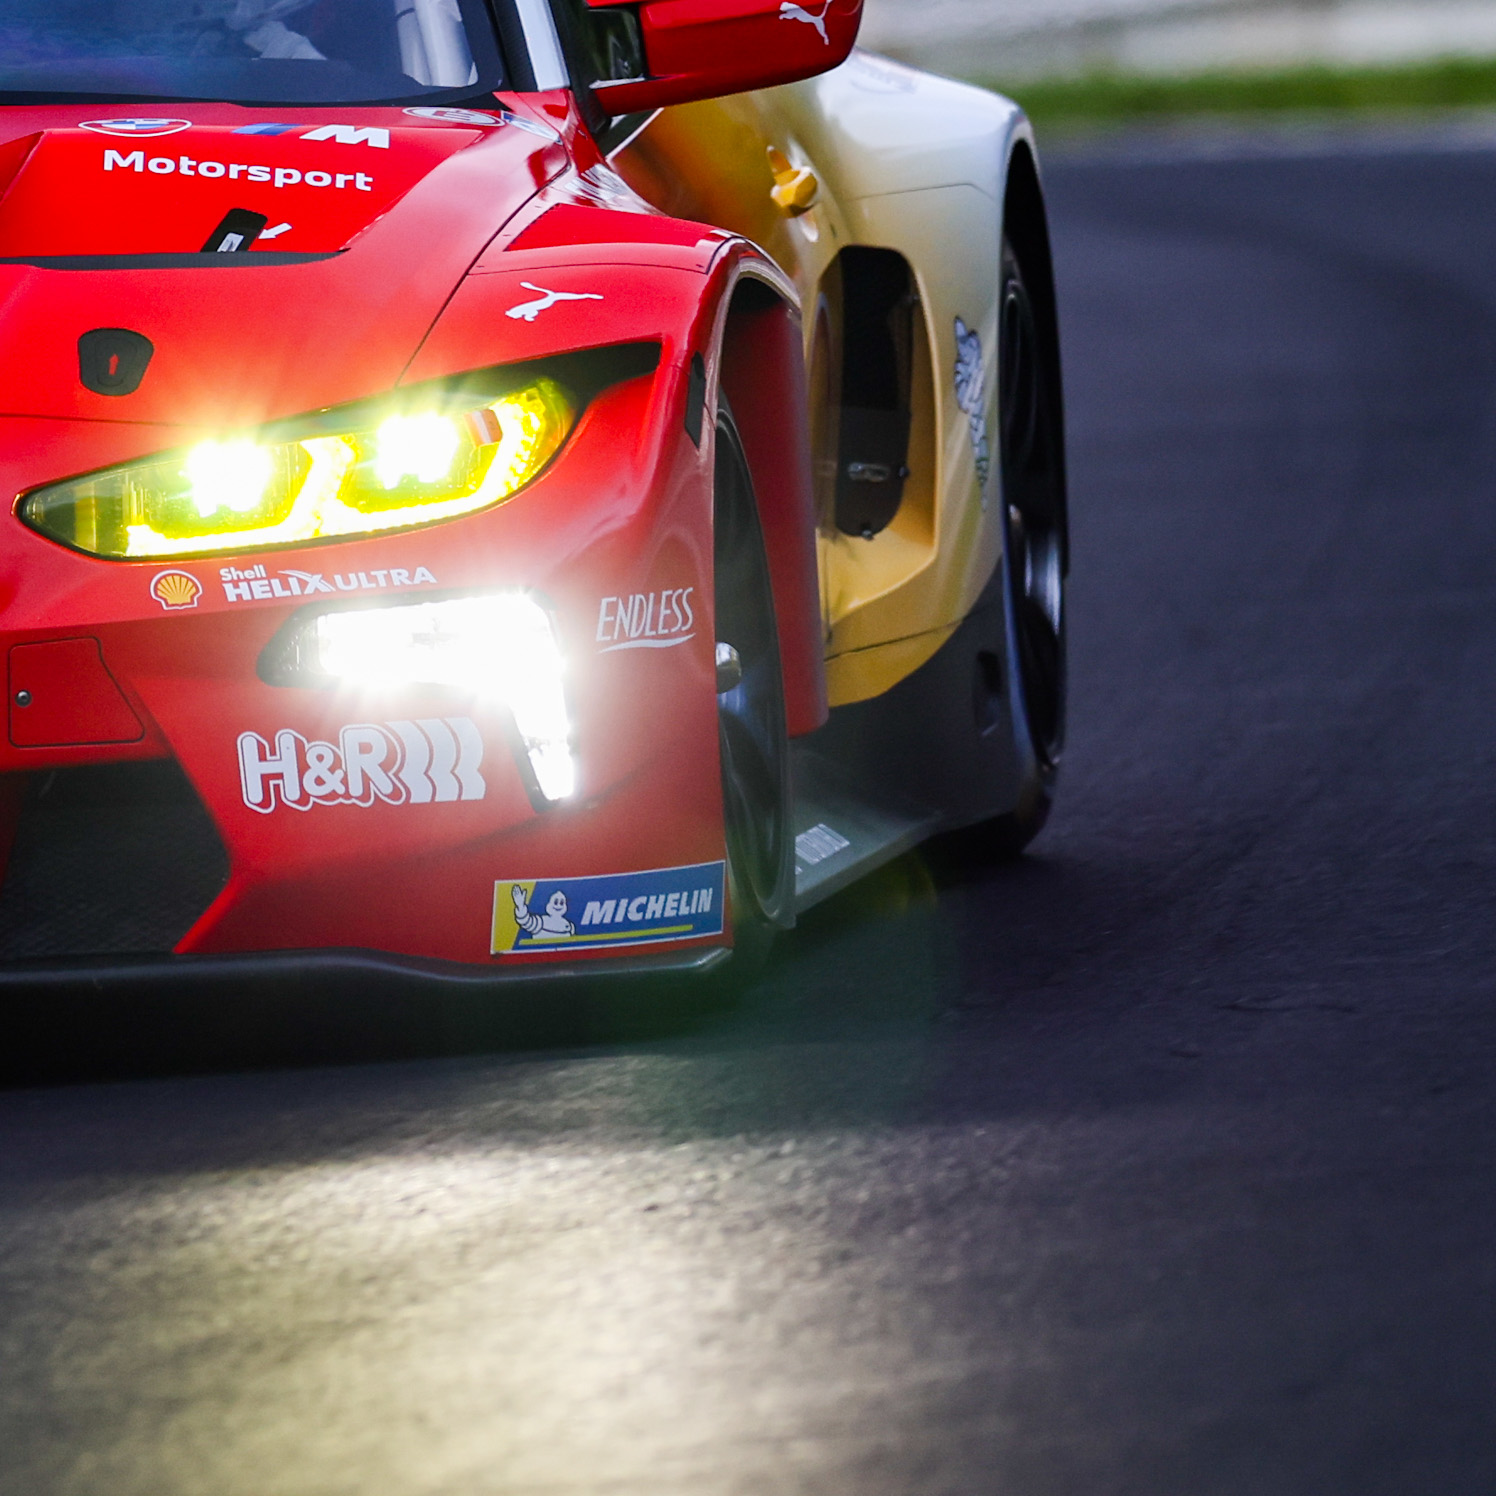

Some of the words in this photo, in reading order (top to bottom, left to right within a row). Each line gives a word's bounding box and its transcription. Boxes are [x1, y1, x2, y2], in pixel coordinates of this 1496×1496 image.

[103, 149, 374, 192] Motorsport
[218, 564, 267, 582] Shell
[221, 569, 337, 602] HELIX
[334, 566, 438, 591] ULTRA
[595, 586, 695, 642] ENDLESS
[236, 723, 407, 814] H&R
[580, 887, 714, 926] MICHELIN
